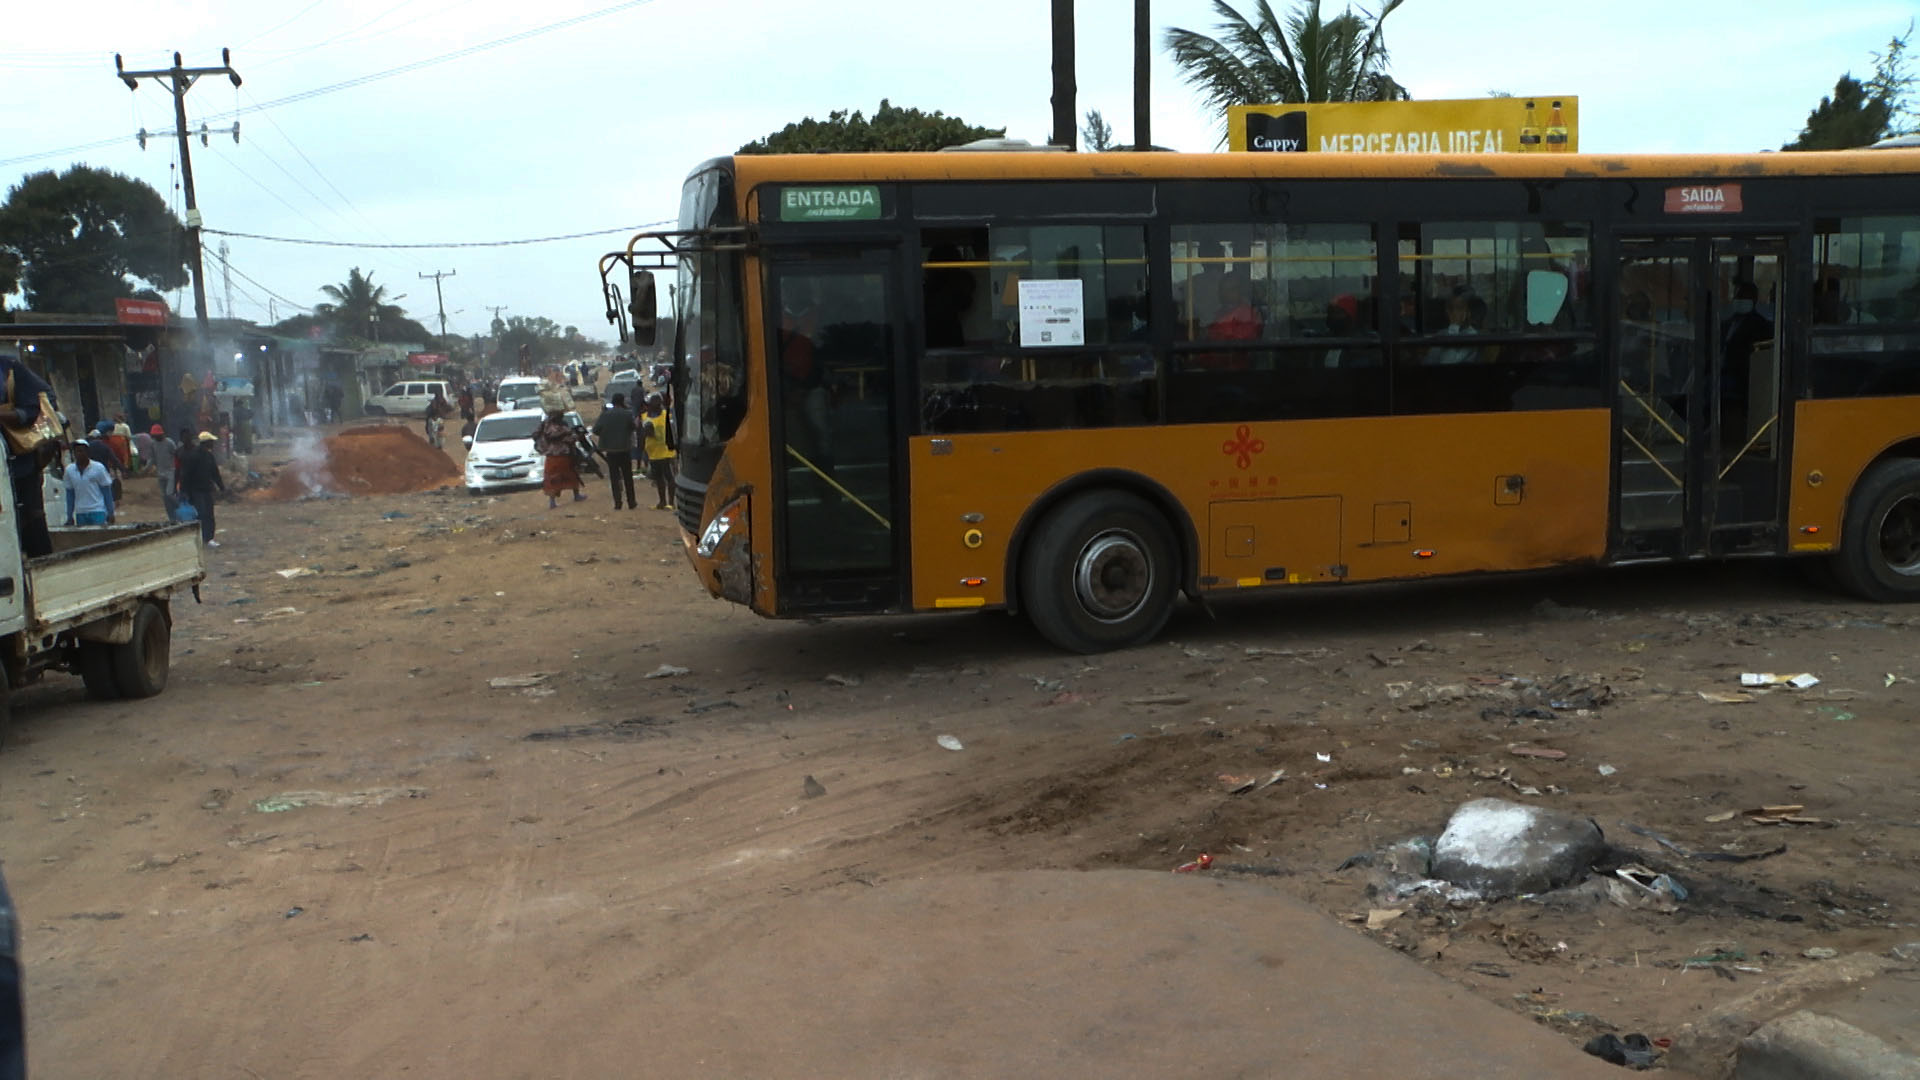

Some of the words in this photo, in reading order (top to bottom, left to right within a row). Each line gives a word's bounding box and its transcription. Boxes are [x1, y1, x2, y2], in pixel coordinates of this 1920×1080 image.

[1253, 135, 1300, 152] Cappy
[1320, 131, 1441, 153] MERCEARIA
[786, 190, 874, 207] ENTRADA
